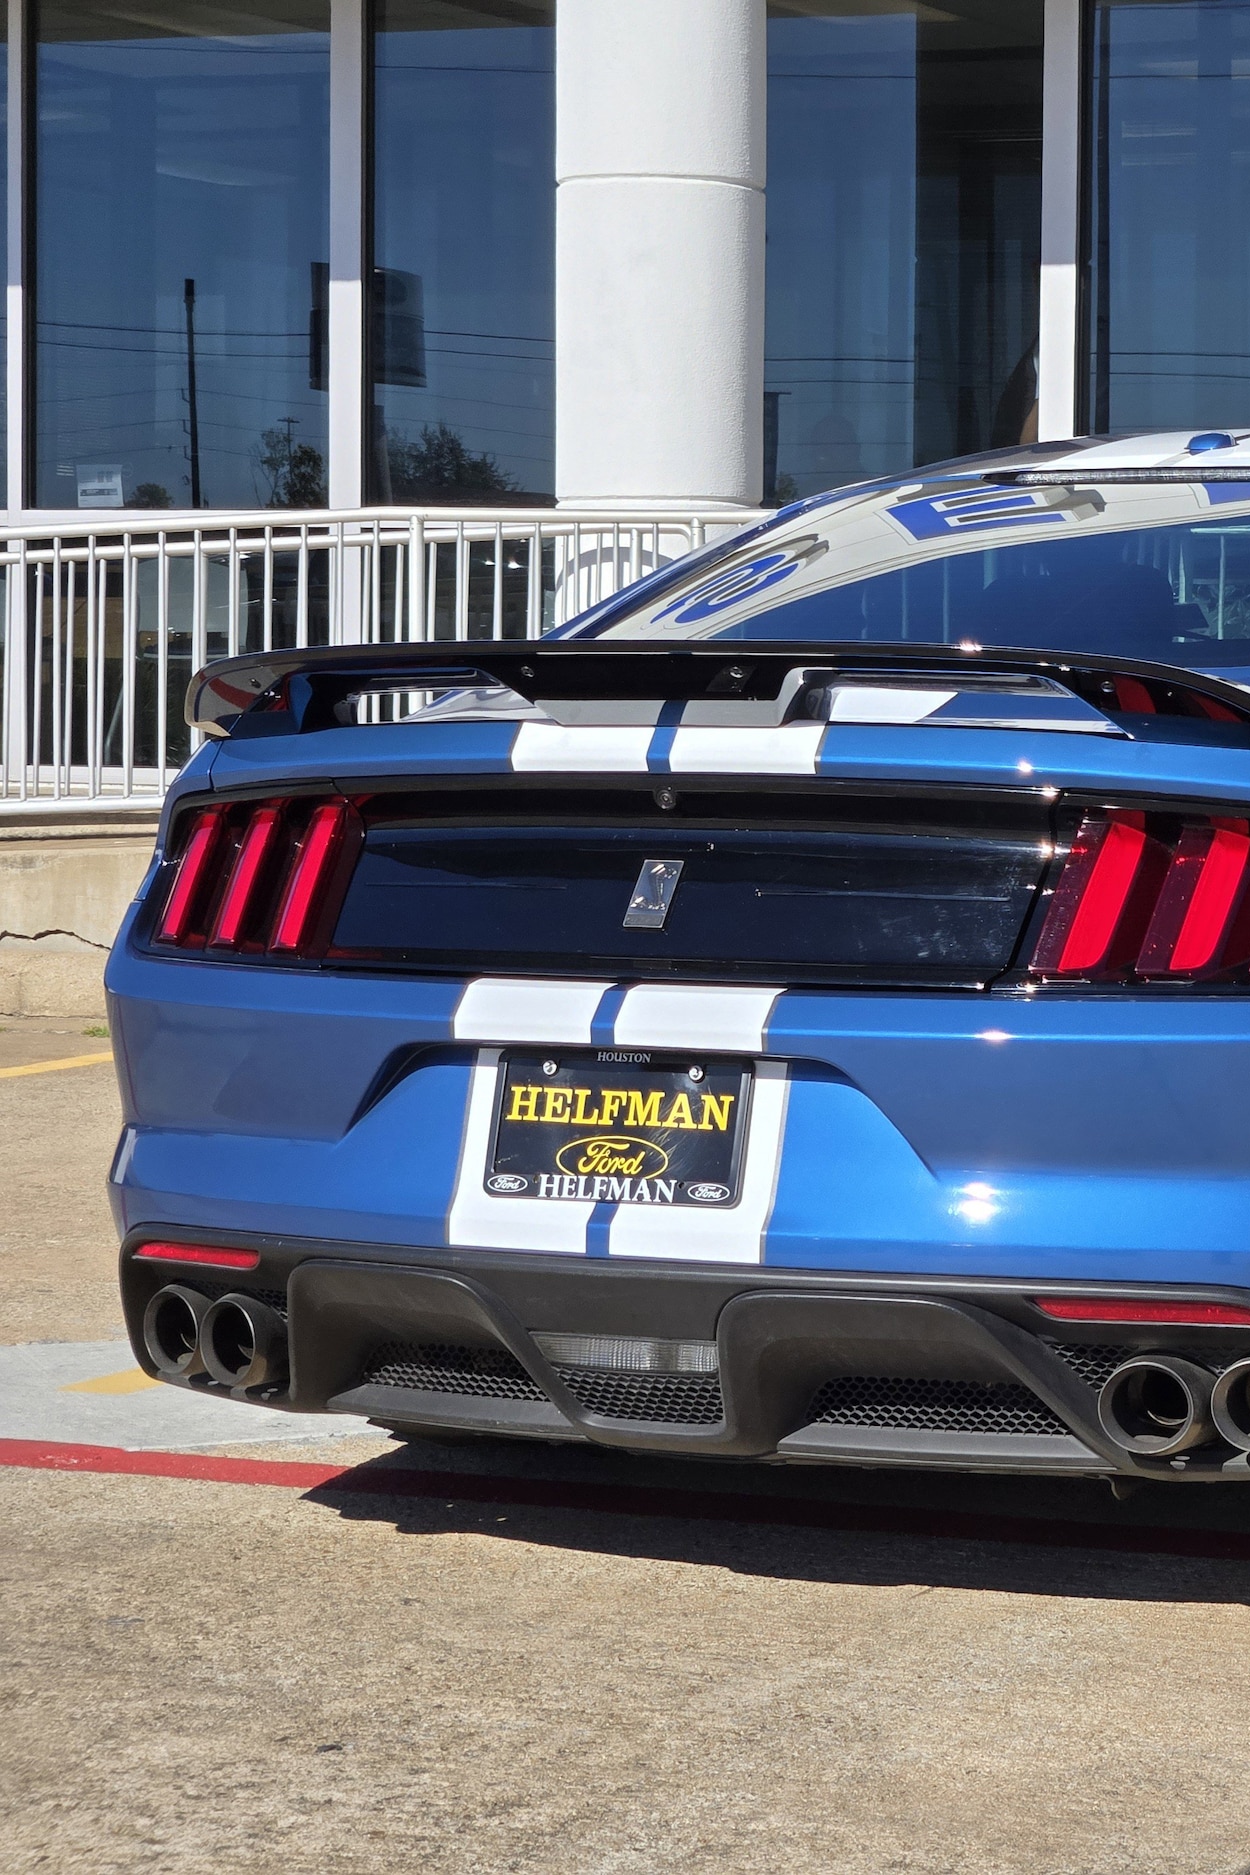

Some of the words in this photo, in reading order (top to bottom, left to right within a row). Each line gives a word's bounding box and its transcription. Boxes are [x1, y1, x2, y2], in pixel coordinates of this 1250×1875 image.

[597, 1051, 652, 1064] HOUSTON
[505, 1085, 735, 1132] HELFMAN
[577, 1139, 646, 1176] Ford
[494, 1177, 519, 1190] Ford
[537, 1173, 678, 1204] HELFMAN
[695, 1186, 722, 1199] Ford
